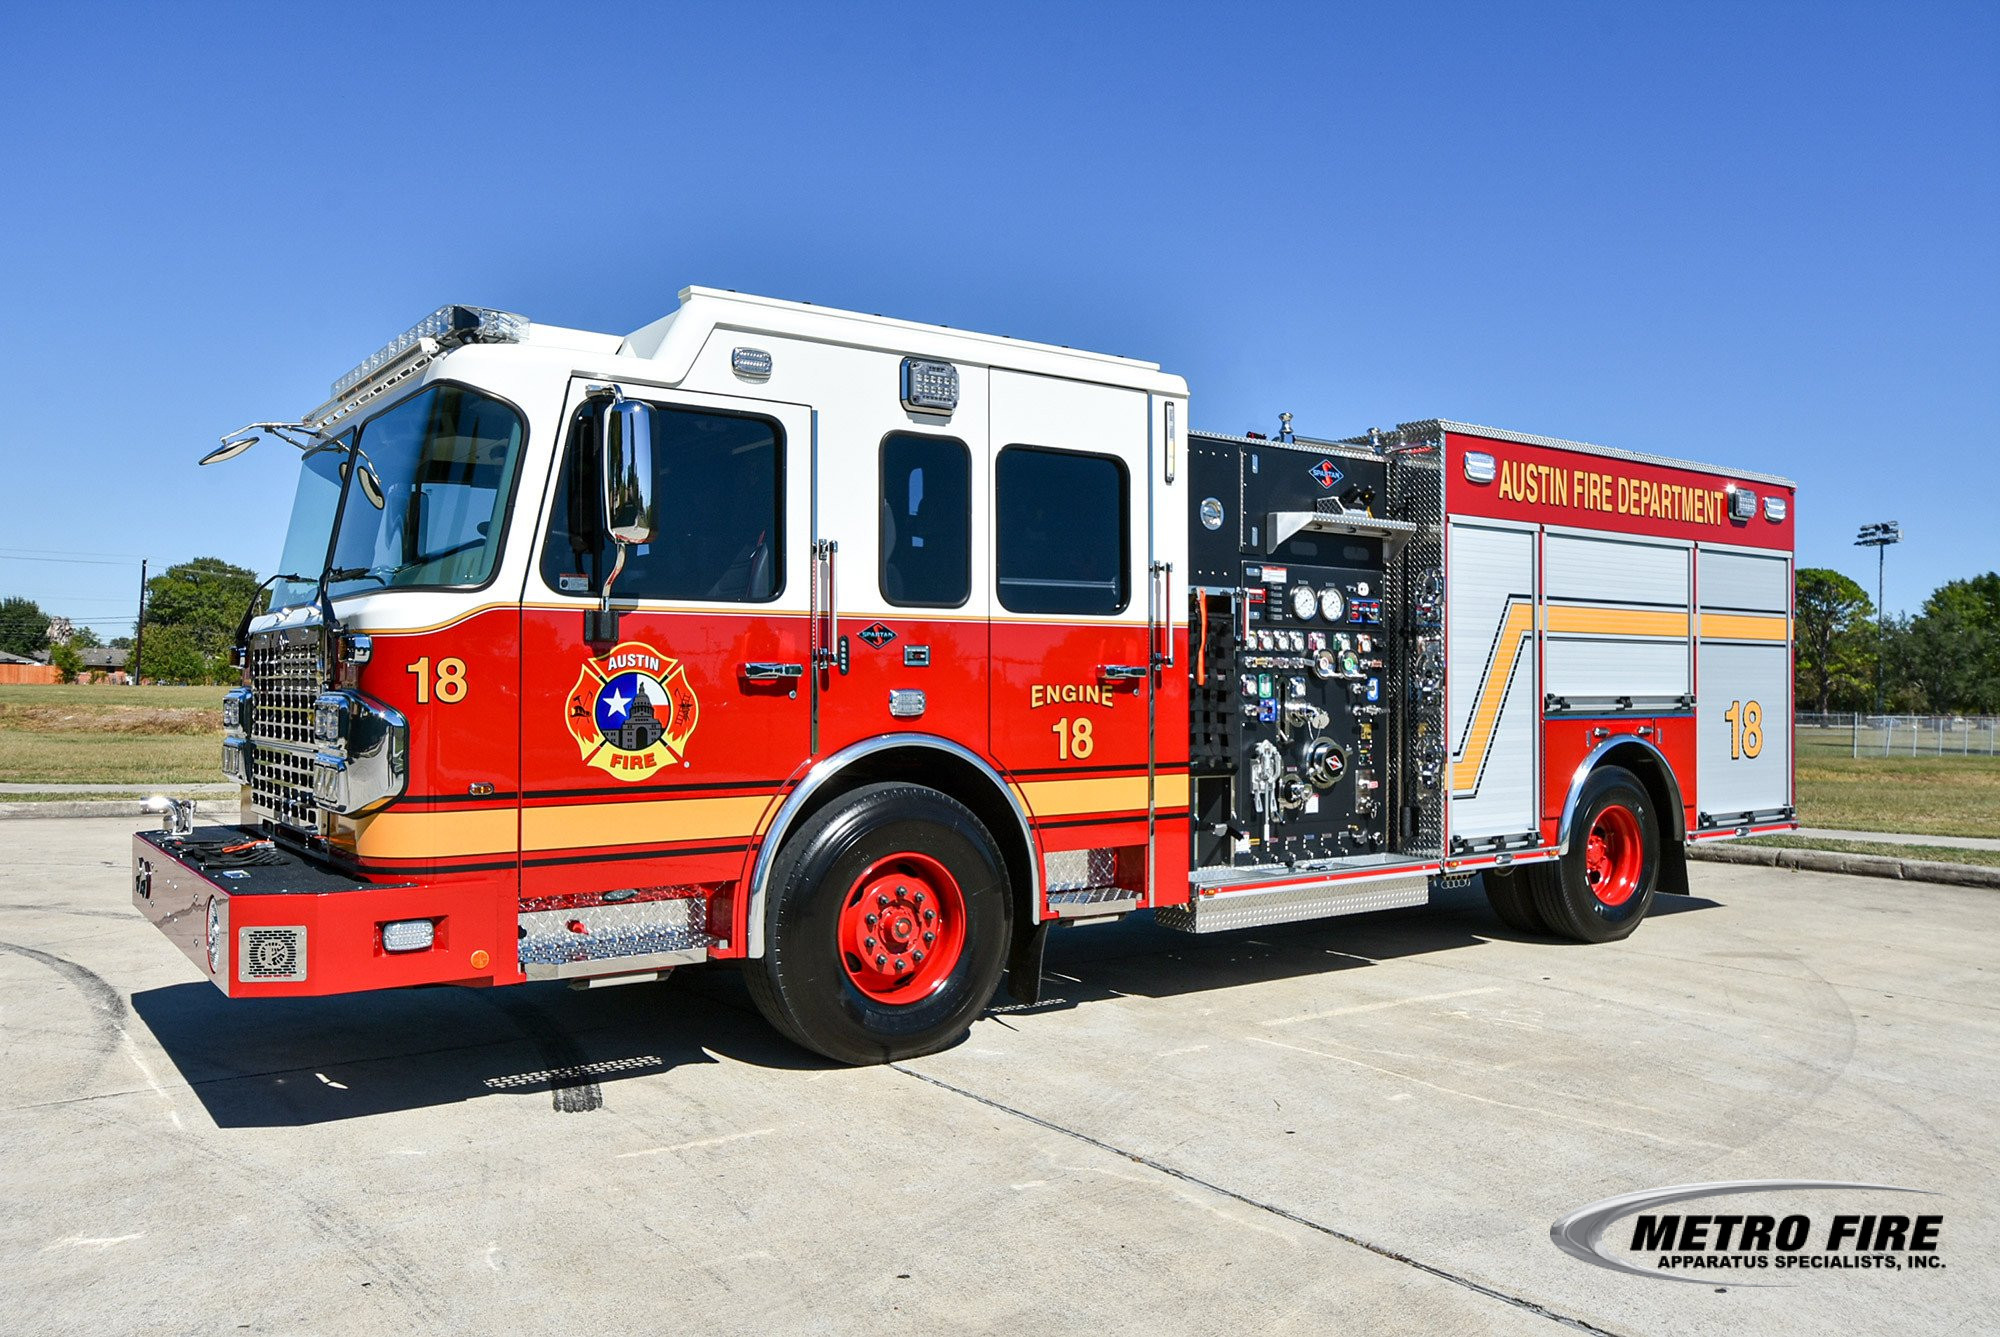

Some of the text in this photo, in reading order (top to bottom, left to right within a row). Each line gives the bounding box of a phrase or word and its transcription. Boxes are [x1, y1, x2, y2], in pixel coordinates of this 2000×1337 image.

[1498, 459, 1724, 526] AUSTIN FIRE DEPARTMENT
[406, 656, 468, 705] 18
[608, 653, 660, 672] AUSTIN
[1030, 684, 1114, 709] ENGINE
[1051, 717, 1094, 761] 18
[1724, 700, 1764, 760] 18
[609, 752, 657, 770] FIRE
